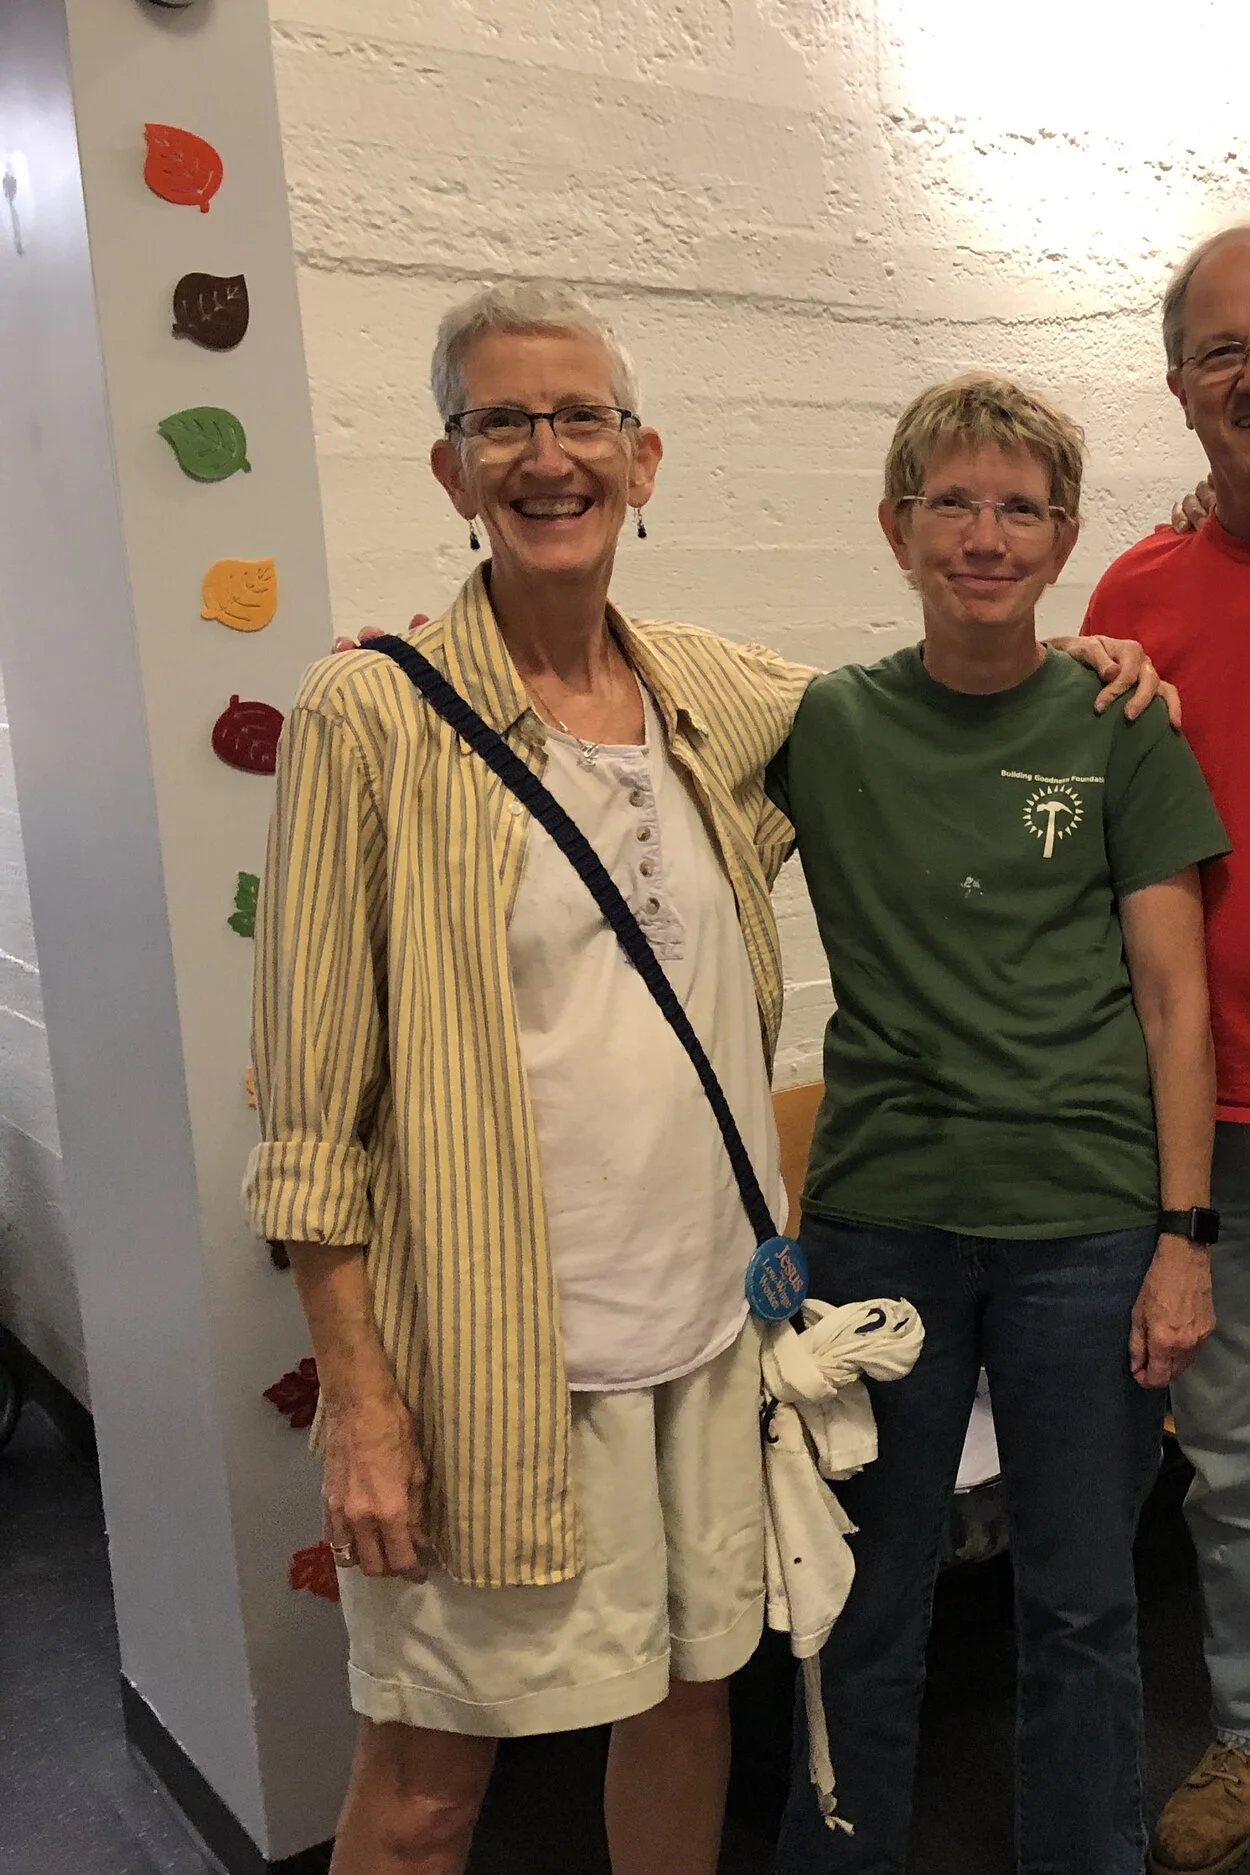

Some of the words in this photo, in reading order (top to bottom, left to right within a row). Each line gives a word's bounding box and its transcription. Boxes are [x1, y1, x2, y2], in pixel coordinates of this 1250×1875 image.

[1001, 769, 1033, 782] Building
[1034, 774, 1070, 784] Goodness
[775, 1244, 804, 1293] Jesus
